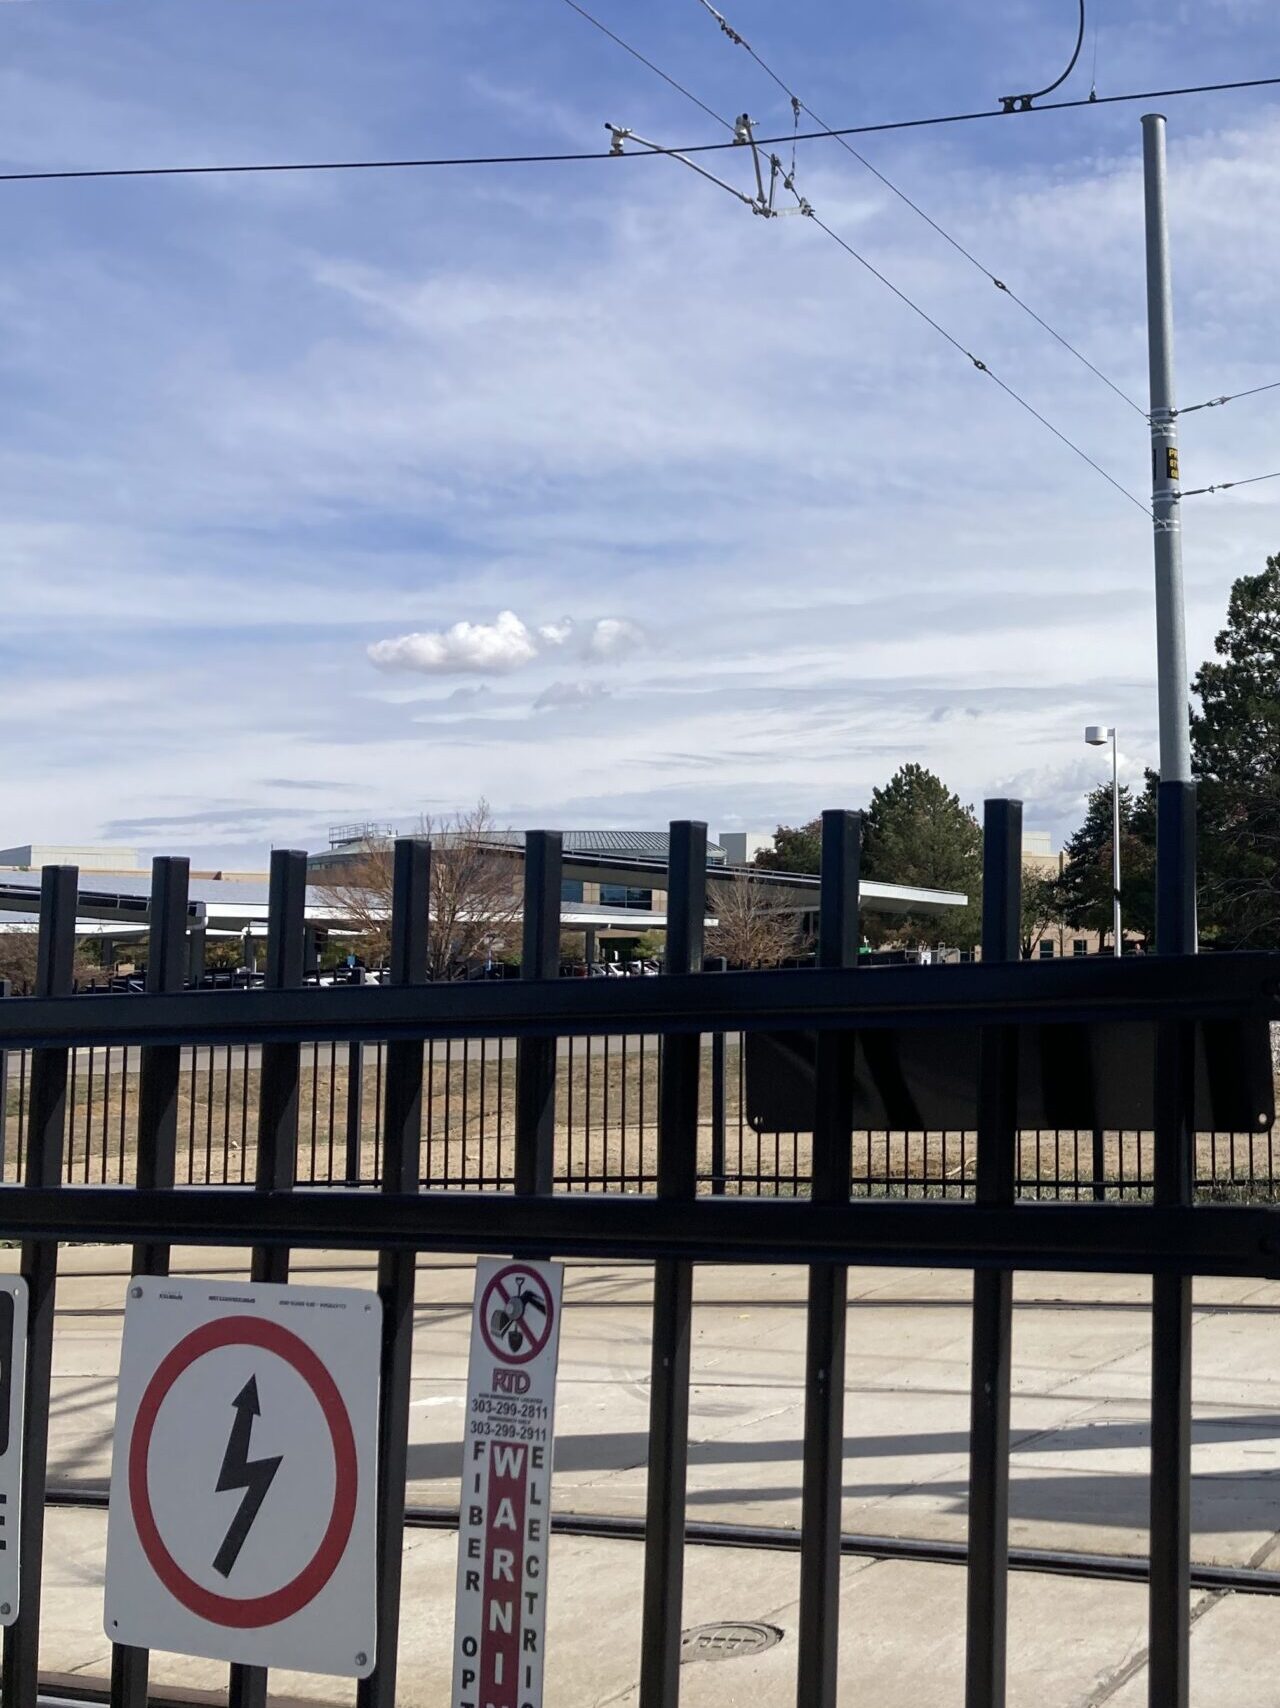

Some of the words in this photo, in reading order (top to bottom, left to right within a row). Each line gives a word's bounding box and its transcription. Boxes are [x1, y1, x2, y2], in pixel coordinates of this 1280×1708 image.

[472, 1399, 548, 1419] 303-299-2811
[492, 1368, 531, 1395] RTD
[470, 1420, 546, 1442] 303-299-2911
[465, 1441, 485, 1592] FIBER
[485, 1445, 525, 1708] WARNI
[521, 1446, 544, 1708] ELECTRI
